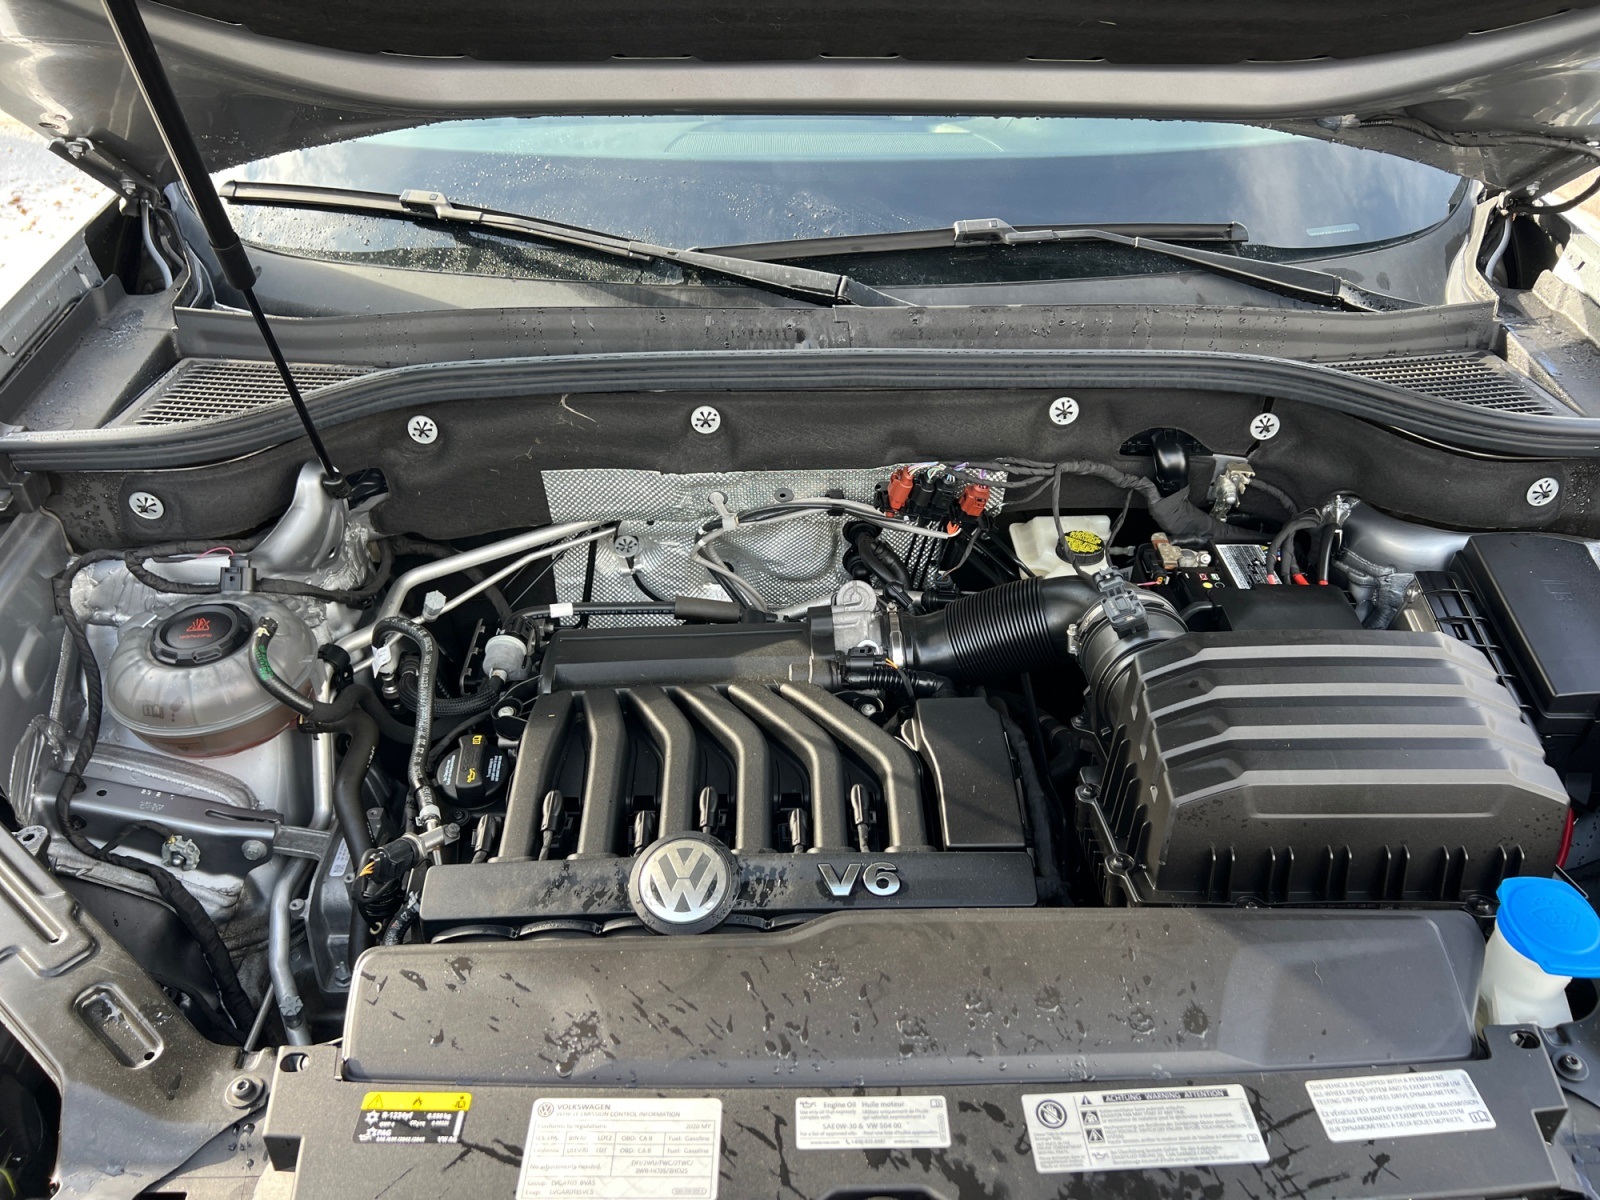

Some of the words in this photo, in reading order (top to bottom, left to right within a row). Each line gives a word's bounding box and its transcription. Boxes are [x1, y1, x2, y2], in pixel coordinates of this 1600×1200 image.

[817, 862, 900, 897] V6
[1105, 1093, 1142, 1102] ACHTUNG
[1144, 1091, 1181, 1100] WARNING
[1184, 1089, 1224, 1098] ATTENTION
